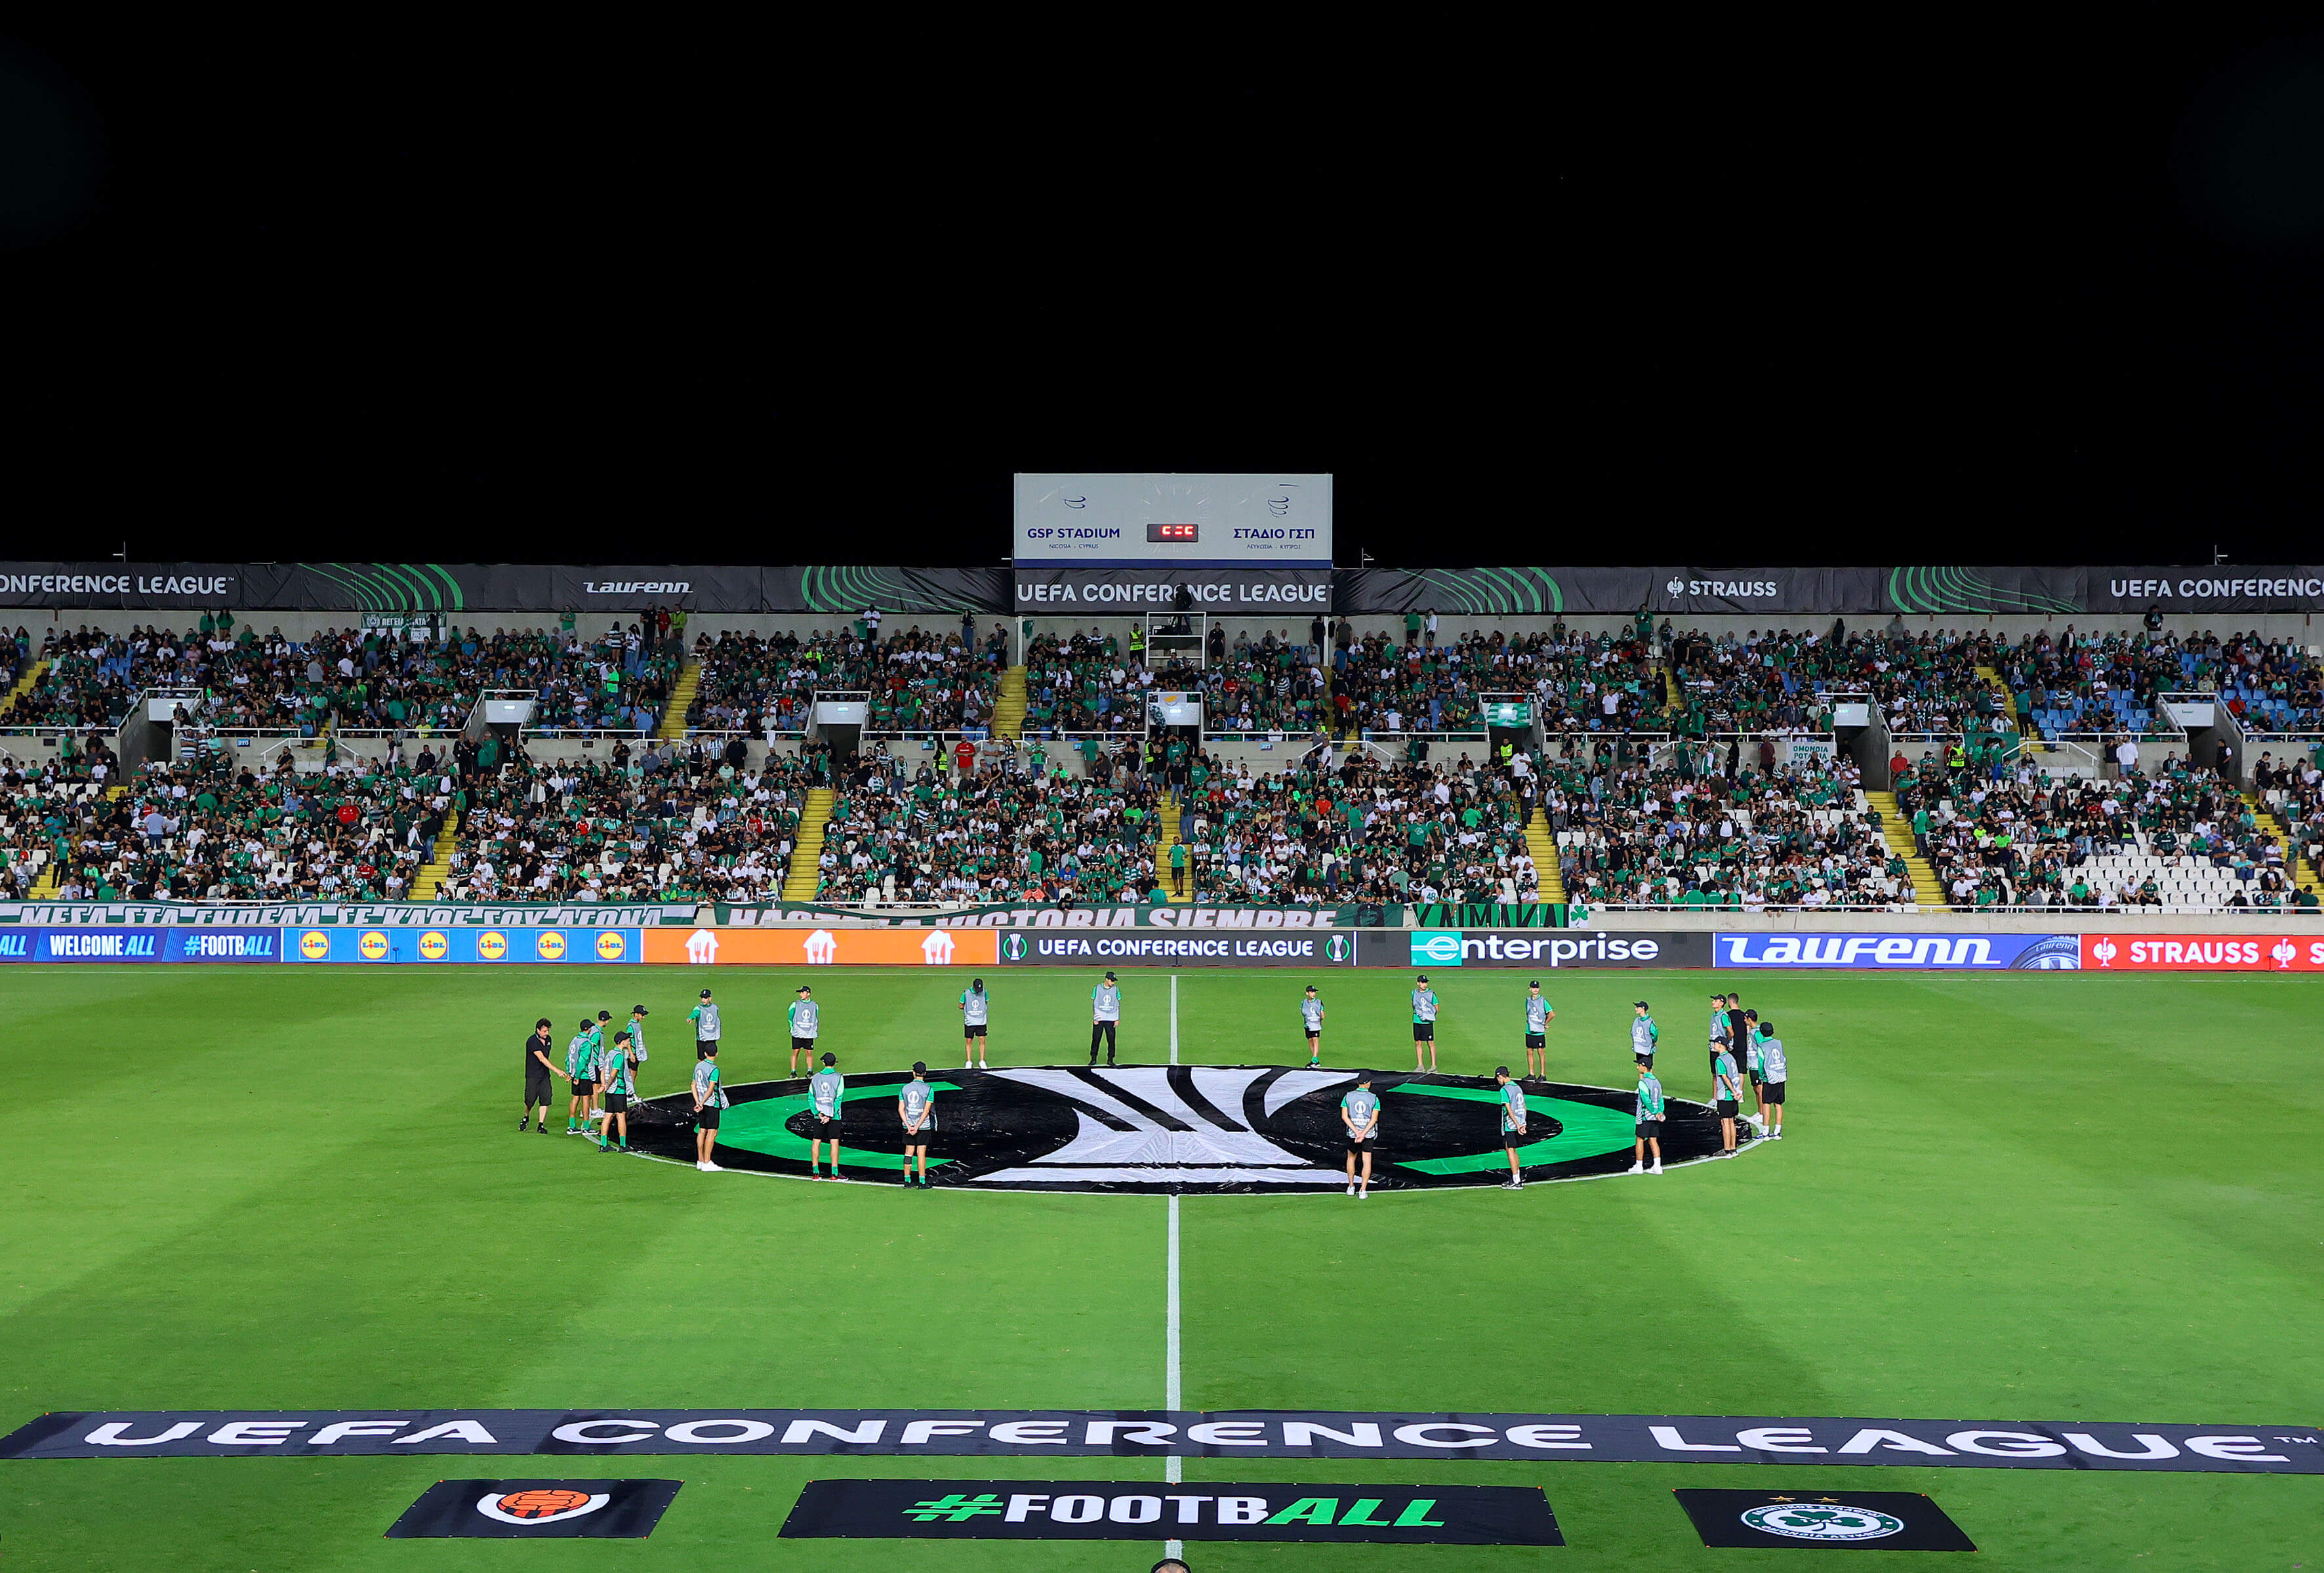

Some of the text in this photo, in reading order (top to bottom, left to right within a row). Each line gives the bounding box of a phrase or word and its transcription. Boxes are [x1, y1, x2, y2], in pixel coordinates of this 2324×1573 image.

[1027, 527, 1120, 539] GSP STADIUM
[1233, 527, 1315, 539] ΣΤΑΔΙΟ ΓΣΠ
[1017, 583, 1078, 602] UEFA
[1688, 580, 1778, 598] STRAUSS
[2110, 578, 2324, 598] UEFA CONFERENC
[1427, 892, 1436, 901] 48
[49, 935, 155, 956] WELCOME ALL
[184, 935, 274, 956] #FOOTBALL
[1039, 939, 1313, 956] UEFA CONFERENCE LEAGUE
[1411, 931, 1659, 967] enterprise
[2130, 941, 2260, 964] STRAUSS
[84, 1421, 498, 1446] UEFA
[552, 1420, 1593, 1449] CONFERENCE
[902, 1494, 1444, 1527] #FOOTBALL
